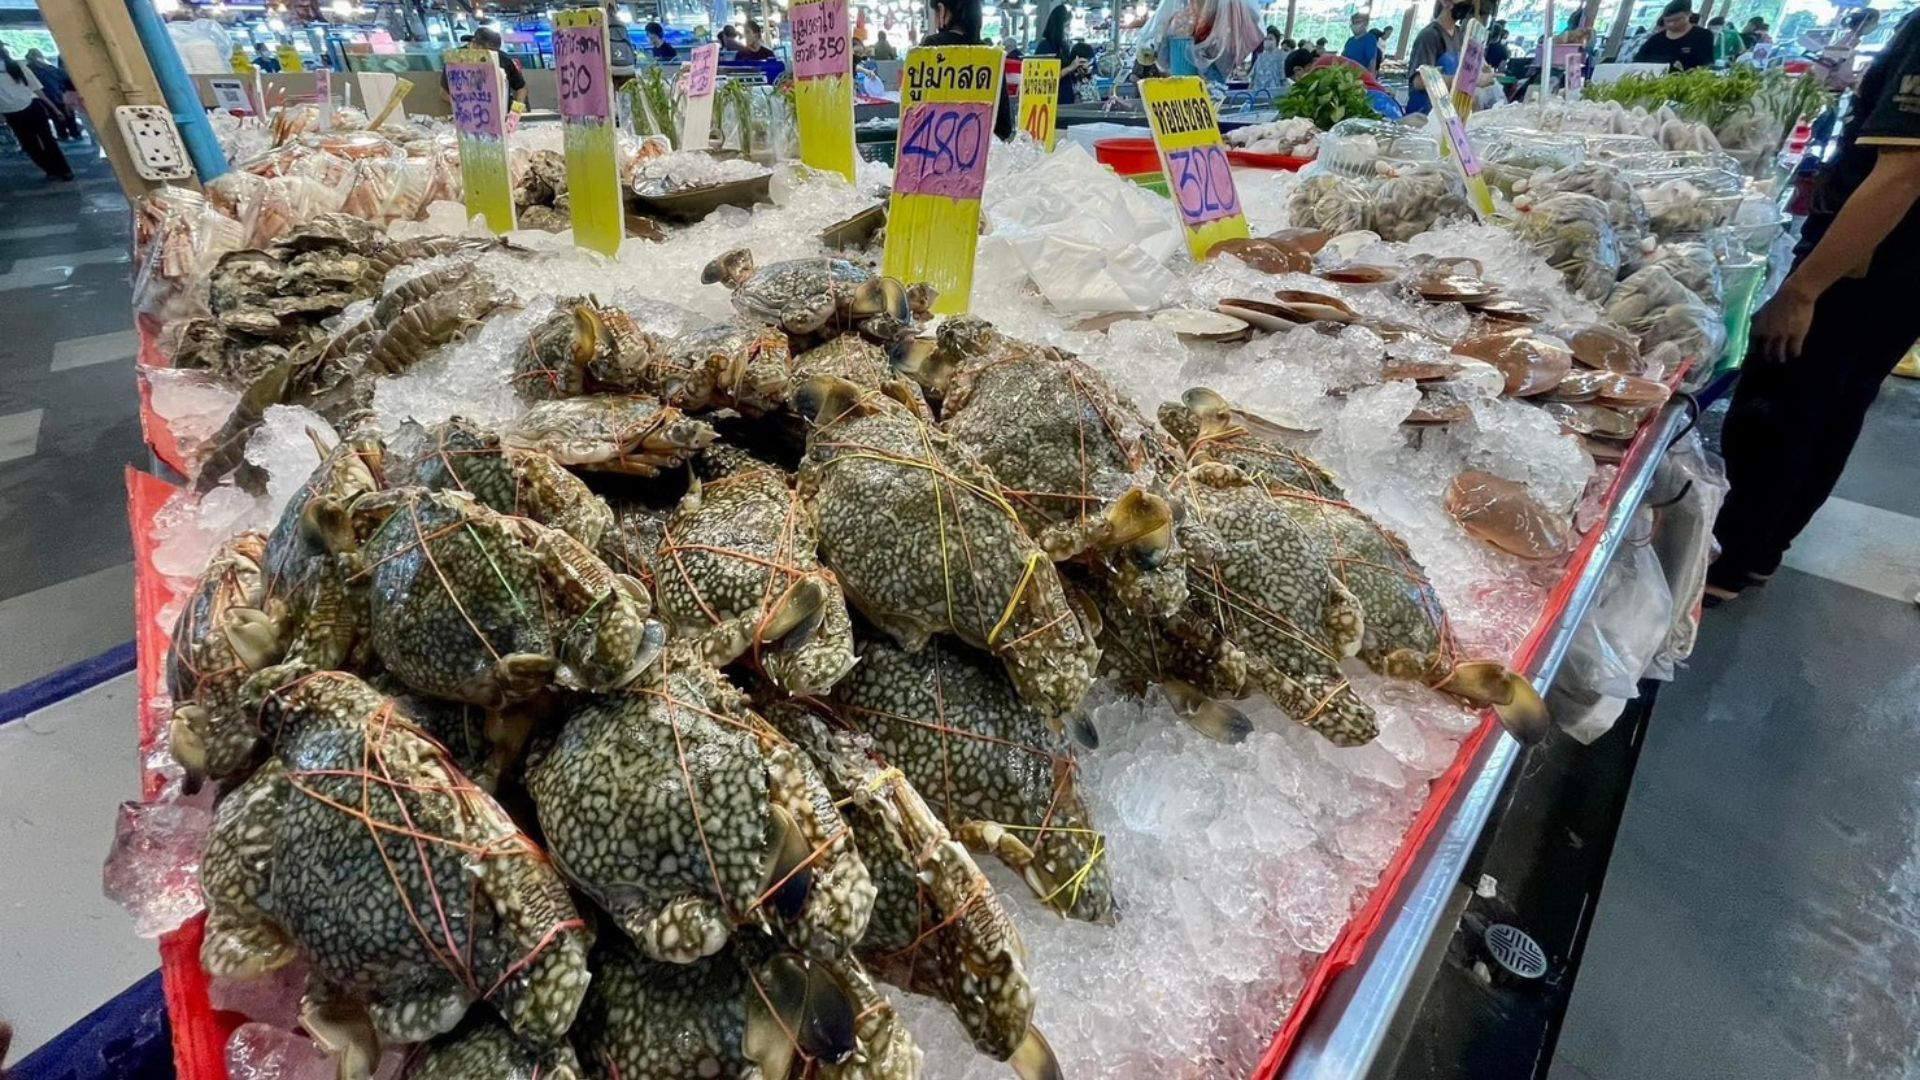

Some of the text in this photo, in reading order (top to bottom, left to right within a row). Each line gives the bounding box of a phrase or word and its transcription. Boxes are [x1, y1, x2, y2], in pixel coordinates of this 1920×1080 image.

[818, 36, 846, 60] 350
[560, 61, 592, 100] 520
[907, 53, 992, 101] ปูม้าสด
[902, 109, 984, 179] 480
[1169, 146, 1235, 218] 320
